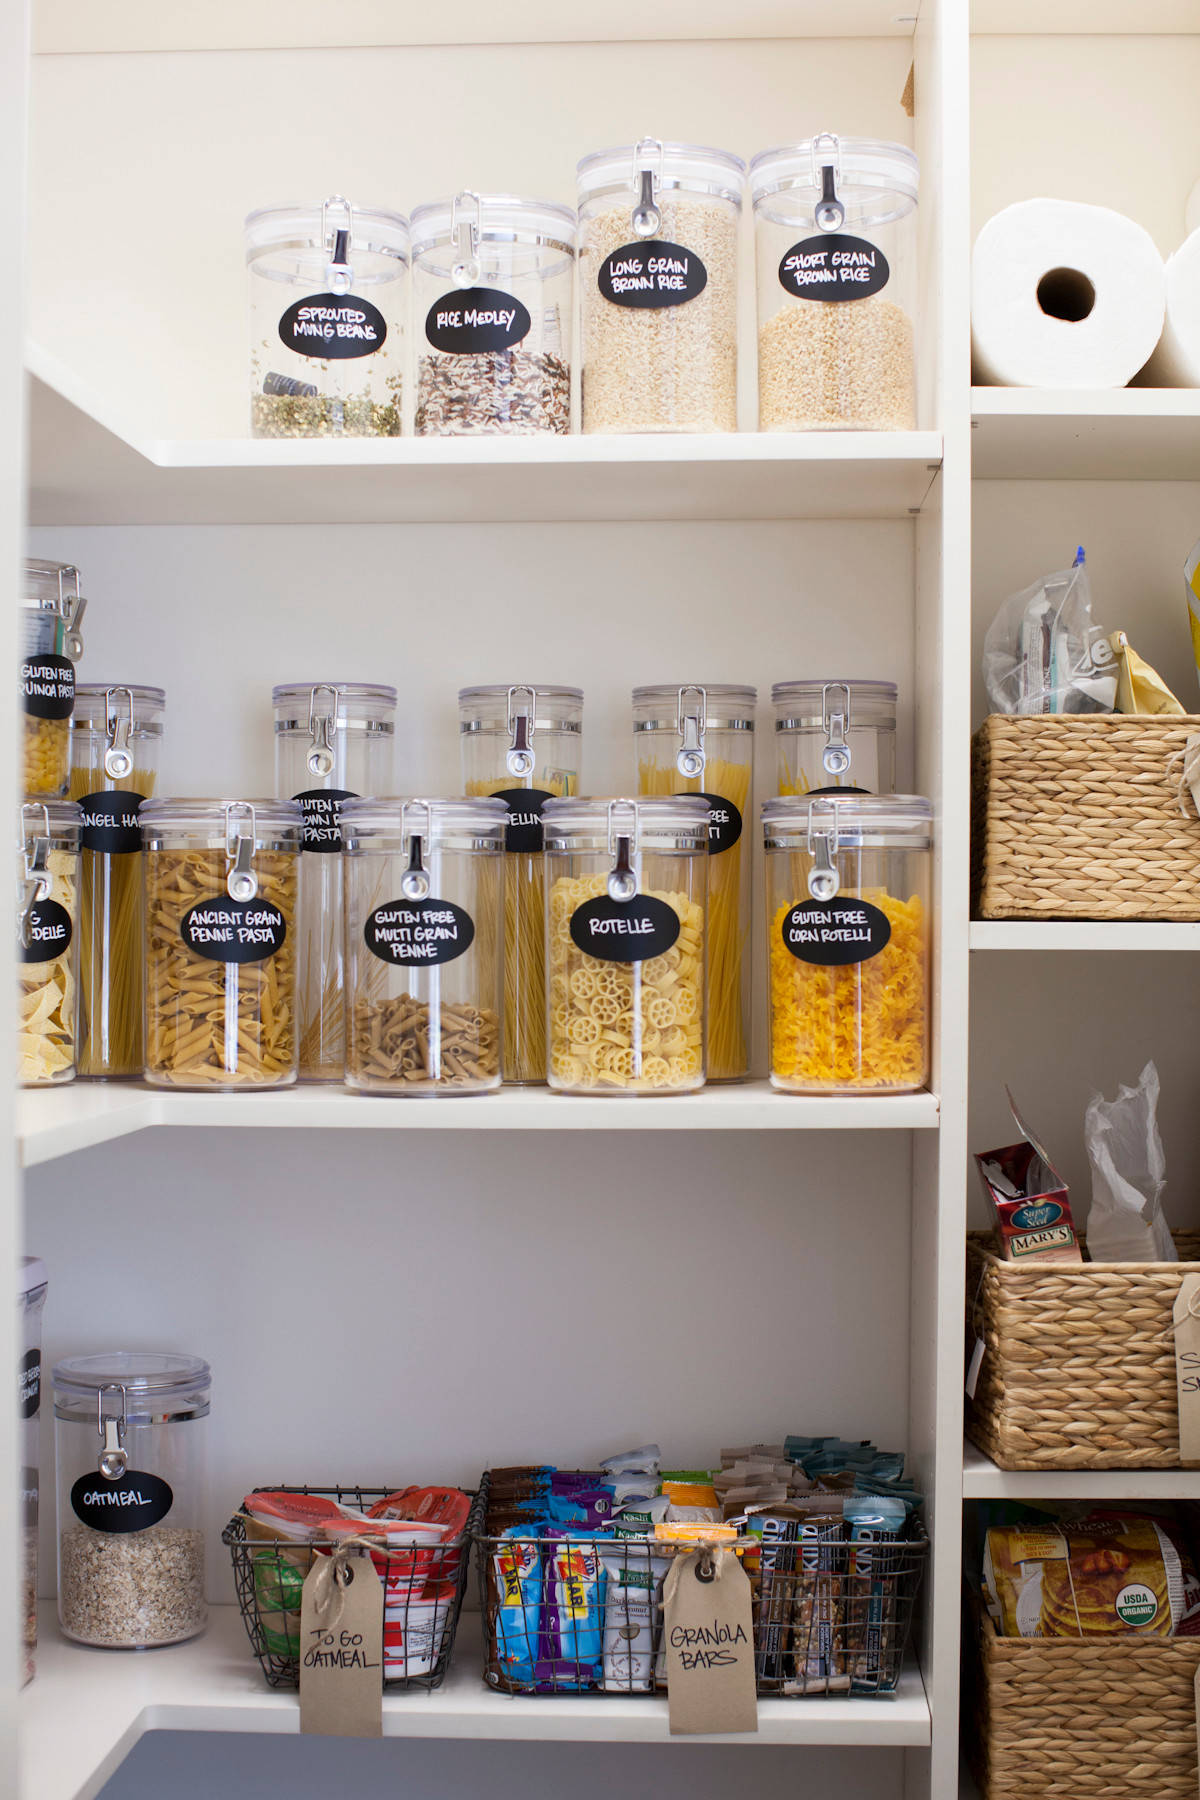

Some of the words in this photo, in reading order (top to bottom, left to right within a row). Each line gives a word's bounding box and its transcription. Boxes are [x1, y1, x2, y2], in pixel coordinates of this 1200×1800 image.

[610, 258, 642, 277] LONG
[648, 258, 688, 275] GRAIN
[784, 252, 828, 271] SHORT
[832, 251, 876, 268] GRAIN
[611, 277, 654, 294] BROWN
[658, 276, 687, 291] RICE
[794, 270, 838, 286] BROWN
[840, 268, 870, 283] RICE
[298, 307, 366, 324] SPROUTED
[437, 311, 462, 329] RICE
[464, 309, 516, 332] MEDLEY
[293, 324, 334, 337] MUNG
[336, 323, 377, 340] BEANS
[20, 664, 58, 680] GLUTEN
[58, 668, 73, 682] FREE
[297, 798, 332, 813] LUTEN
[304, 813, 330, 828] OWN
[304, 828, 342, 842] PASTA
[189, 910, 242, 926] ANCIENT
[245, 910, 282, 926] GRAIN
[374, 910, 420, 924] GLUTEN
[422, 910, 456, 924] FREE
[792, 910, 832, 925] GLUTEN
[832, 910, 868, 924] FREE
[190, 927, 234, 942] PENNE
[238, 928, 275, 944] PASTA
[374, 926, 410, 942] MULTI
[413, 926, 458, 940] GRAIN
[589, 918, 655, 936] ROTELLE
[789, 928, 820, 943] CORN
[821, 926, 872, 943] ROTELLI
[390, 943, 438, 958] PENNE
[1022, 1206, 1050, 1220] Super
[1026, 1216, 1048, 1228] Seed
[1015, 1228, 1068, 1250] MARY'S
[83, 1490, 152, 1506] OATMEAL
[760, 1518, 779, 1570] KIND
[1124, 1594, 1148, 1604] USDA
[1122, 1605, 1153, 1616] ORGANIC
[670, 1619, 748, 1648] GRANOLA
[304, 1649, 380, 1669] OATMEAL
[678, 1649, 738, 1670] BARS
